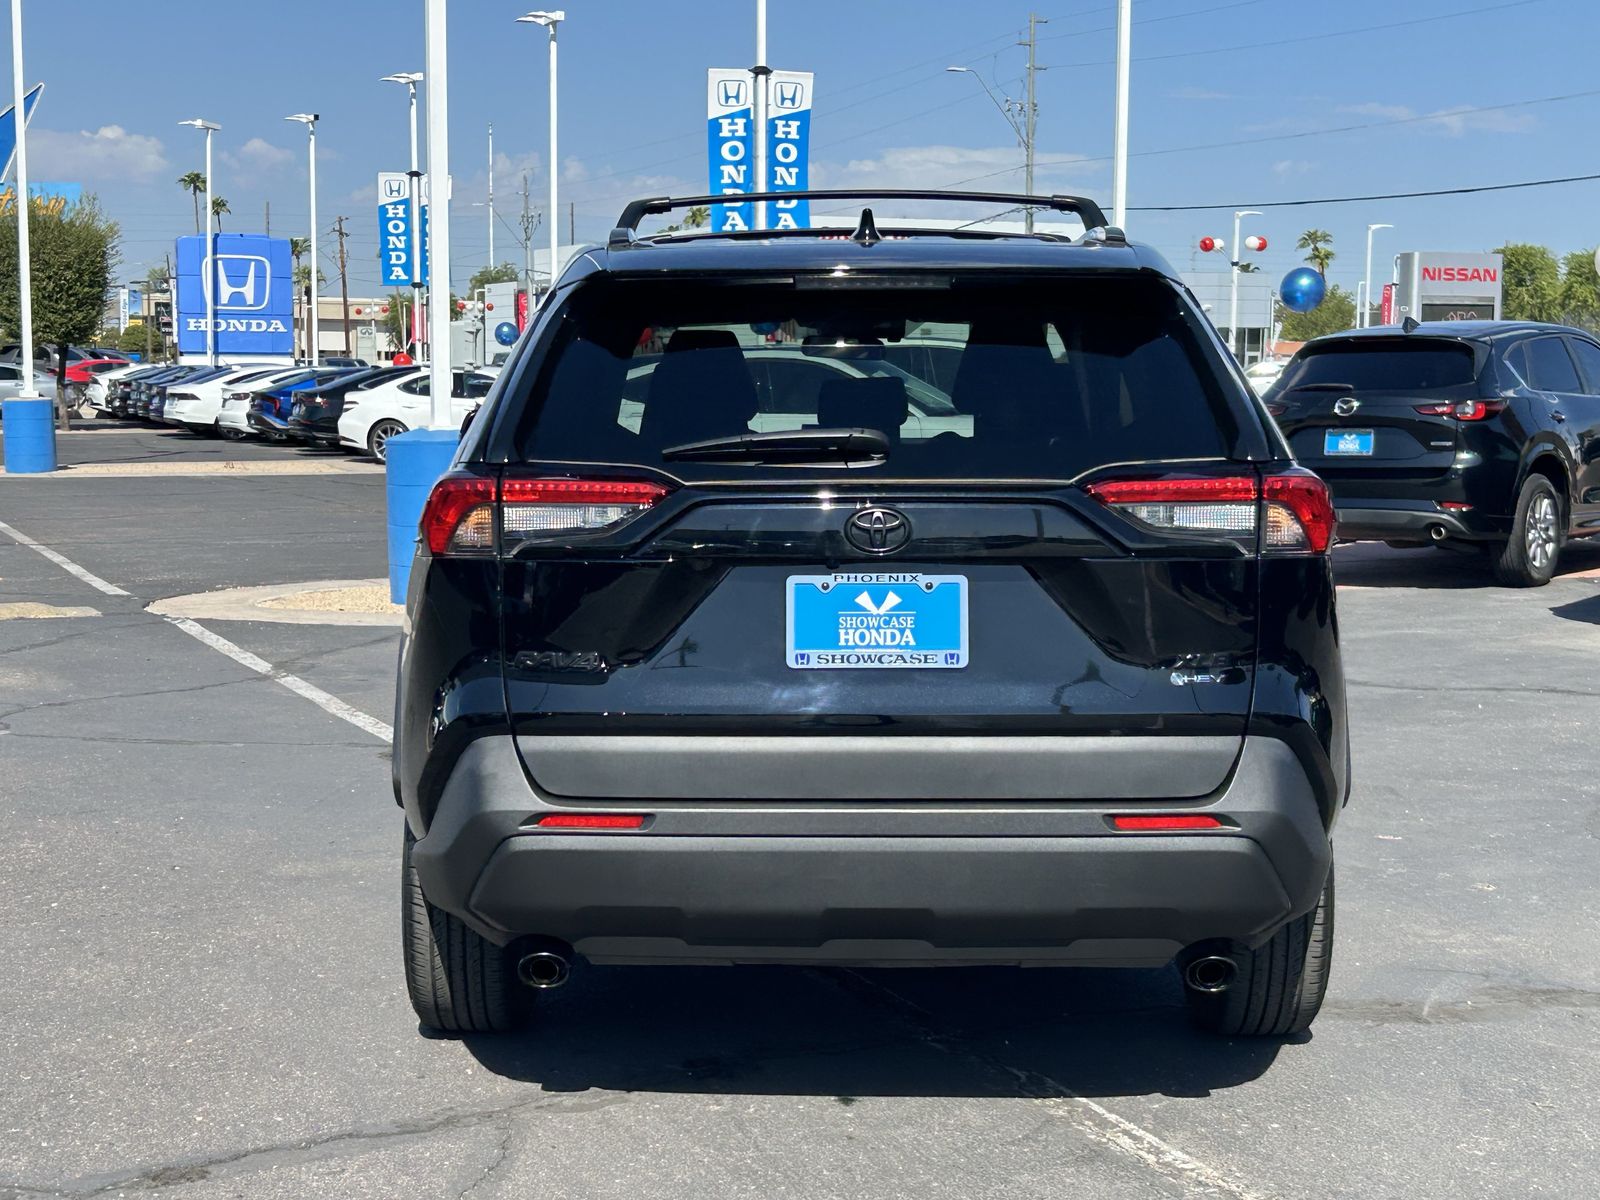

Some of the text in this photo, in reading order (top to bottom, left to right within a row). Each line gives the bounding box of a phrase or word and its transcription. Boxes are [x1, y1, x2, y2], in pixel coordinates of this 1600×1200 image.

[718, 118, 749, 232] HONDA
[774, 120, 801, 230] HONDA
[385, 204, 409, 280] HONDA
[1422, 267, 1497, 282] NISSAN
[187, 318, 288, 332] HONDA
[833, 574, 920, 583] PHOENIX
[838, 616, 915, 628] SHOWCASE
[838, 629, 917, 646] HONDA
[816, 653, 938, 665] SHOWCASE
